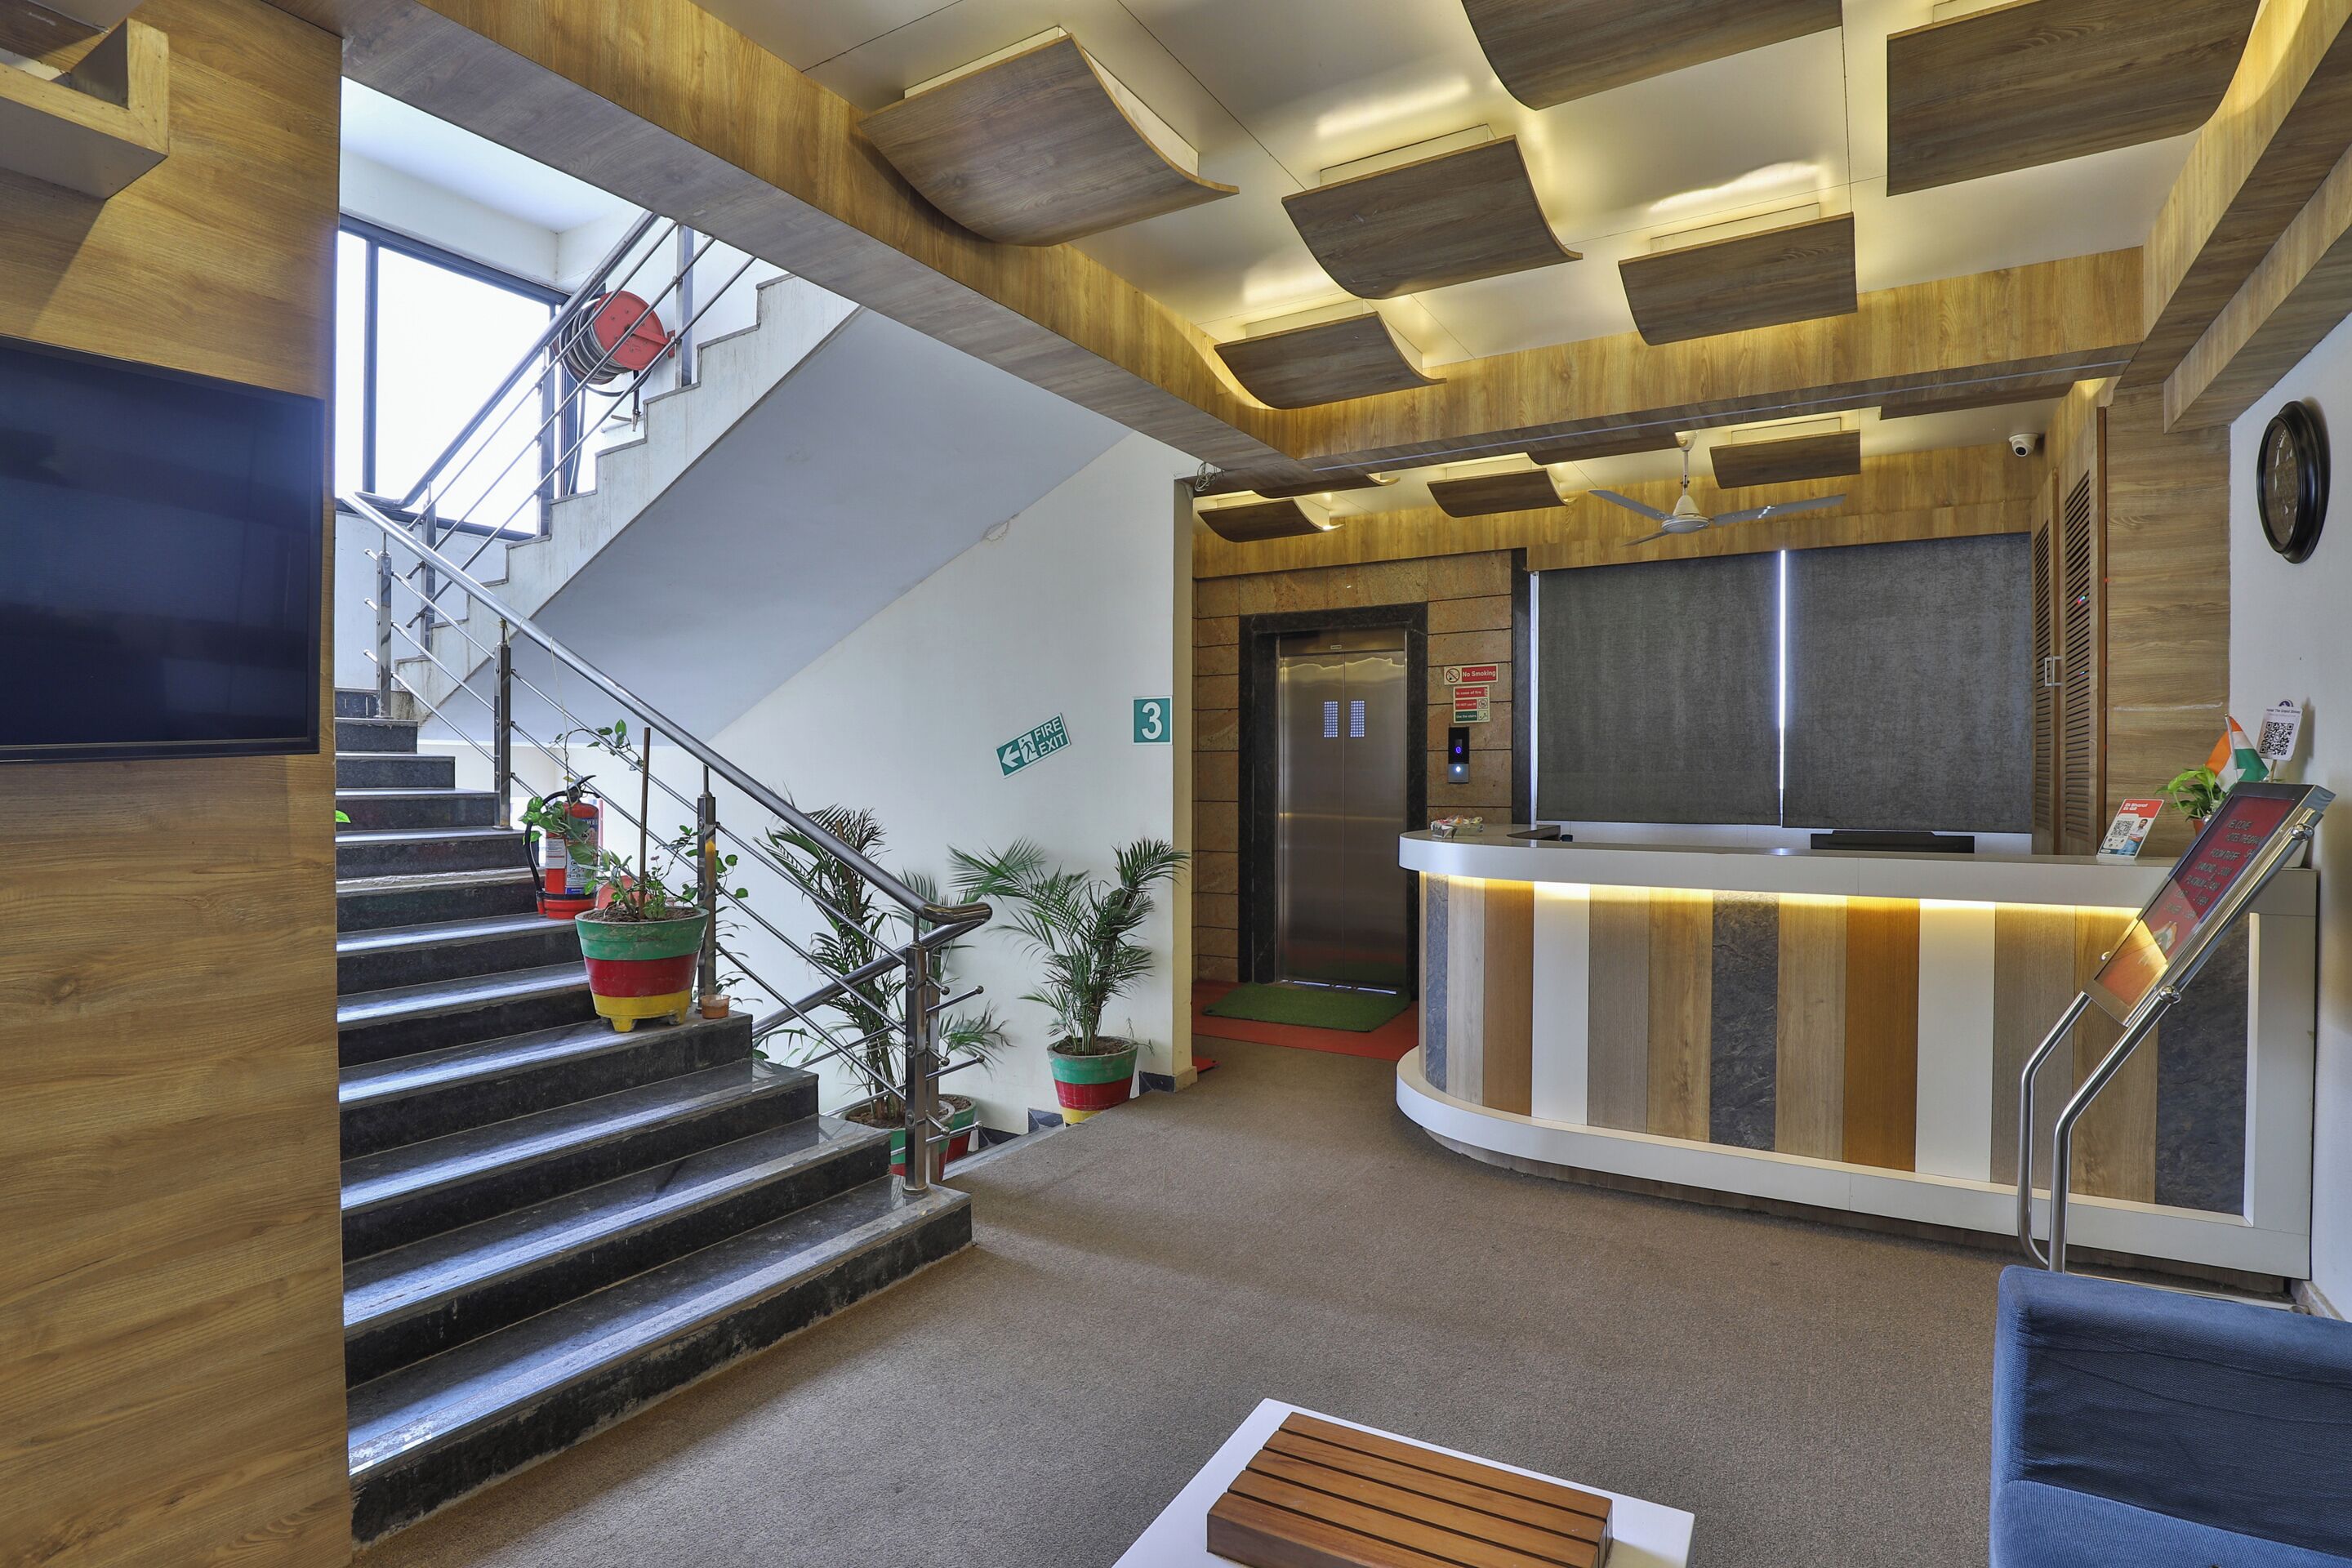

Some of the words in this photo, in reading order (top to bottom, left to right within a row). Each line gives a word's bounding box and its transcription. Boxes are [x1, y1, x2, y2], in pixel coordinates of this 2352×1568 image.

[1034, 718, 1062, 742] FIRE
[1142, 702, 1162, 740] 3
[1038, 733, 1064, 755] EXIT
